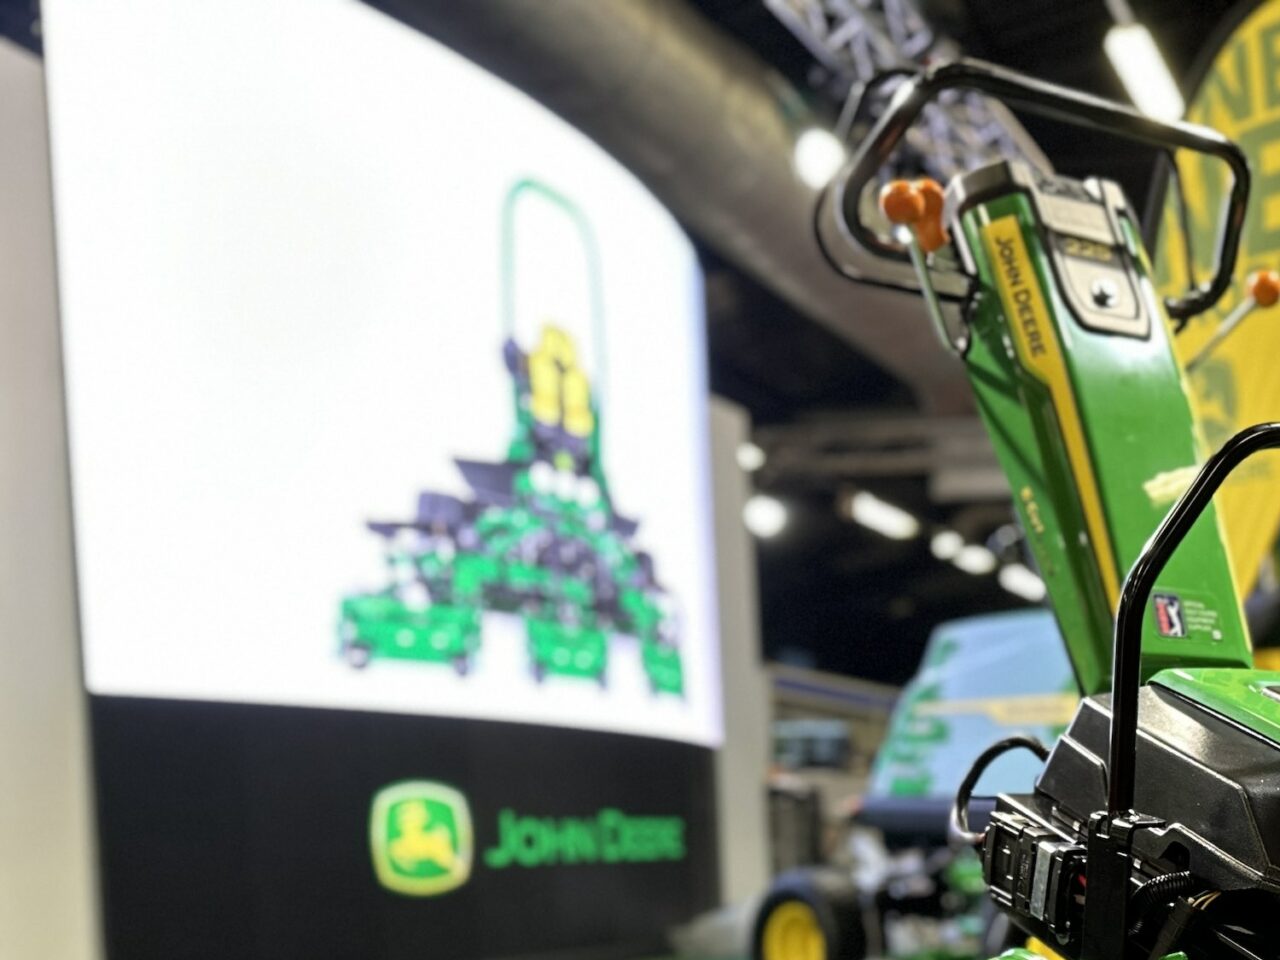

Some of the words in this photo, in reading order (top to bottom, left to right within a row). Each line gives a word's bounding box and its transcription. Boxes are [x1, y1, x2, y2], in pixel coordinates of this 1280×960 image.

[994, 237, 1022, 287] JOHN
[1012, 288, 1046, 357] DEERE
[485, 808, 597, 868] JOHN
